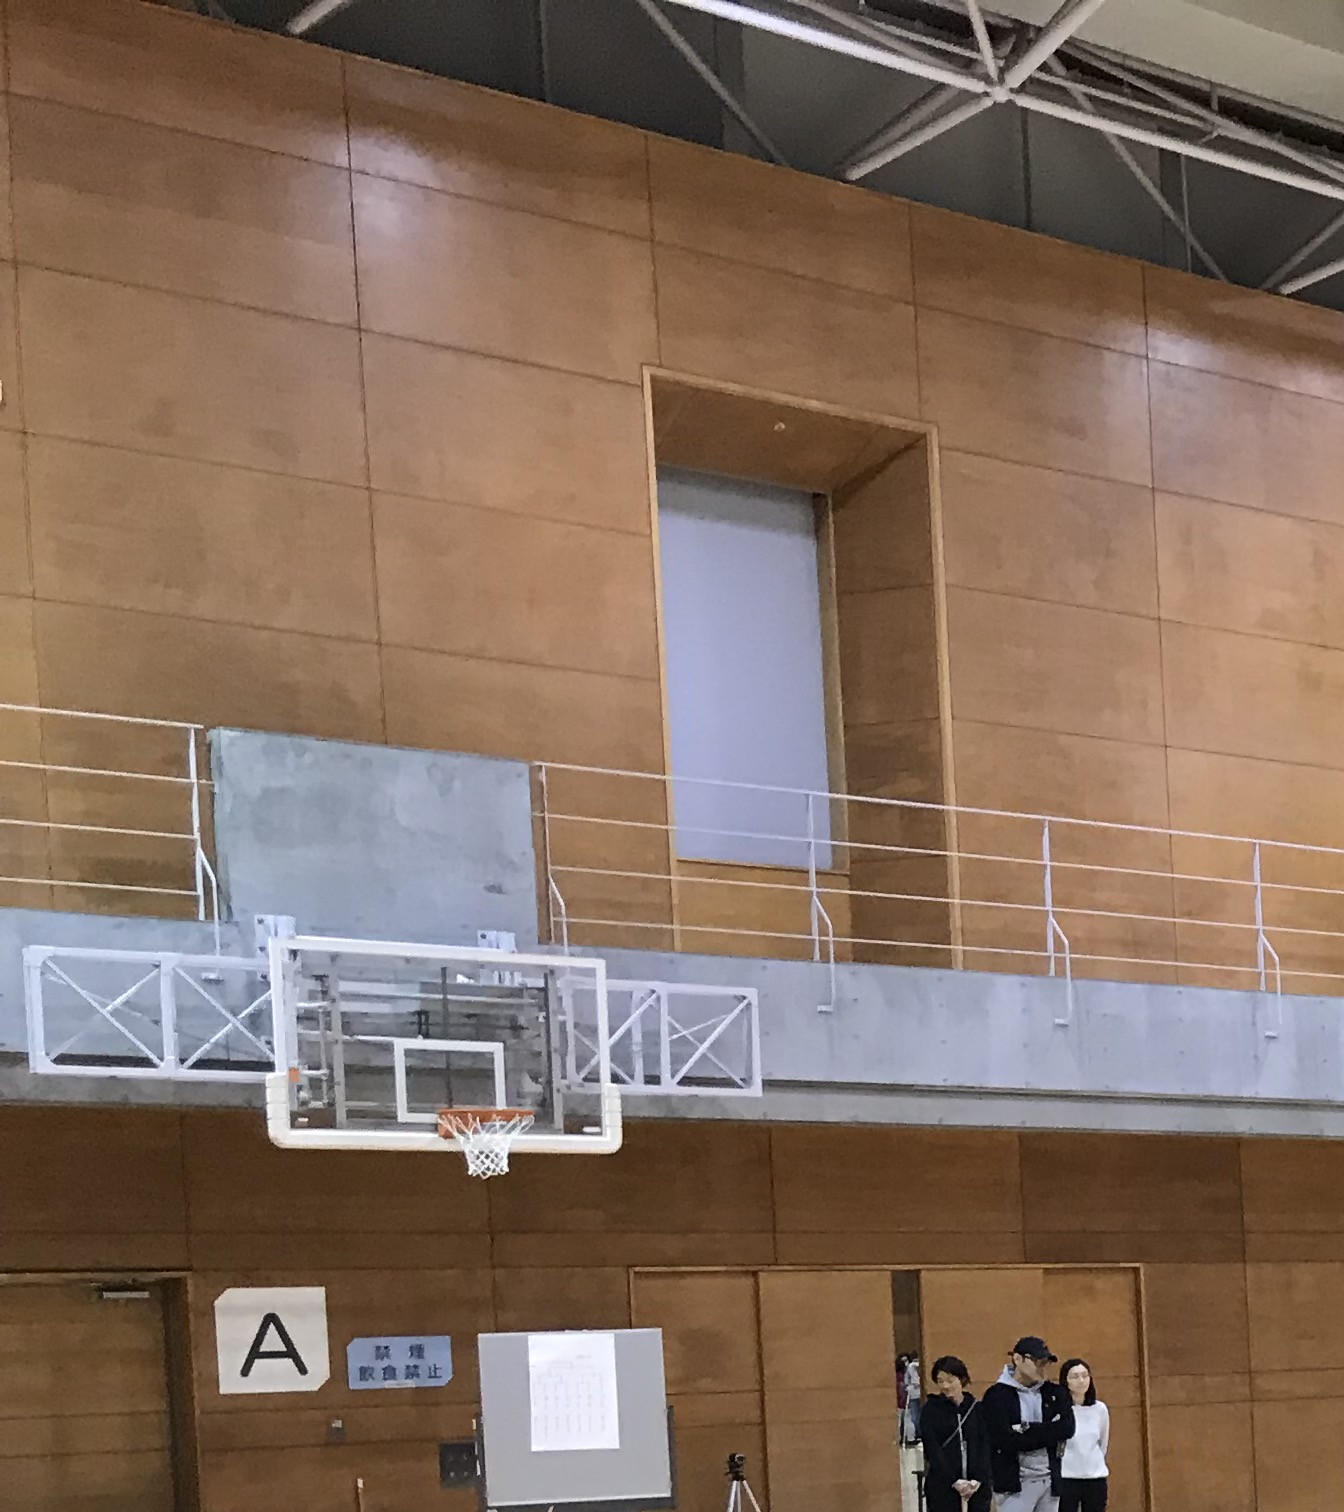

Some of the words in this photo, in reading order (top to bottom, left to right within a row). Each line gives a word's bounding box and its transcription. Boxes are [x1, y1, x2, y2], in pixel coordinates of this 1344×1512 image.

[240, 1312, 309, 1378] A
[358, 1363, 443, 1382] 飲食禁止
